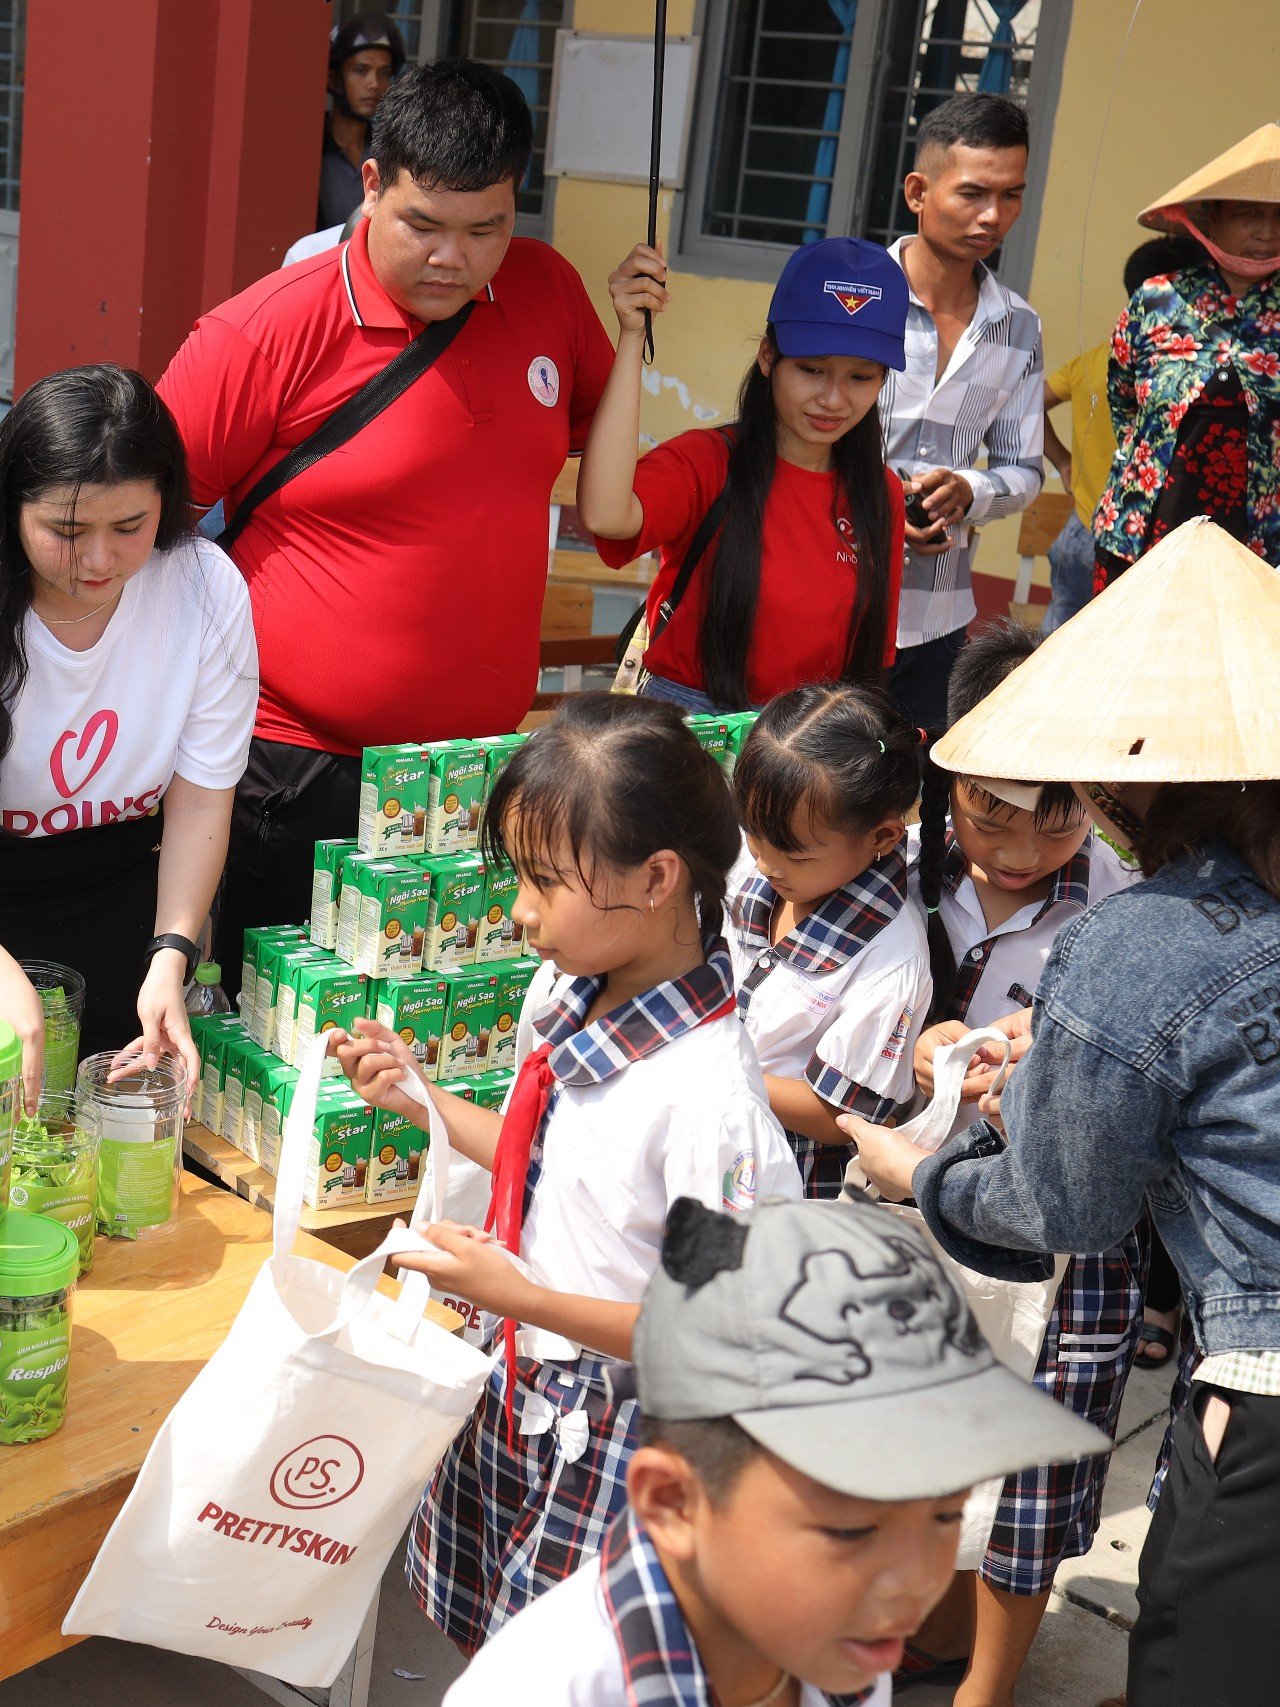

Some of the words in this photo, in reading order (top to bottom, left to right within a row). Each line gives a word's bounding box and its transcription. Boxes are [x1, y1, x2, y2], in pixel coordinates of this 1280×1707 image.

[394, 770, 425, 786] Star
[448, 766, 467, 780] Ngôi
[468, 763, 484, 772] Sao
[453, 884, 480, 900] Star
[492, 877, 511, 891] Ngôi
[390, 891, 409, 905] Ngôi
[411, 888, 428, 898] Sao
[332, 993, 361, 1008] Star
[456, 995, 476, 1009] Ngôi
[478, 992, 494, 1000] Sao
[508, 987, 528, 1001] Sta
[402, 1000, 423, 1013] Ngôi
[426, 998, 442, 1006] Sao
[338, 1124, 367, 1140] Star
[383, 1116, 403, 1132] Ngôi
[63, 1212, 92, 1228] spica
[6, 1353, 69, 1381] Respica
[197, 1502, 358, 1565] PRETTYSKIN
[205, 1616, 248, 1635] Design
